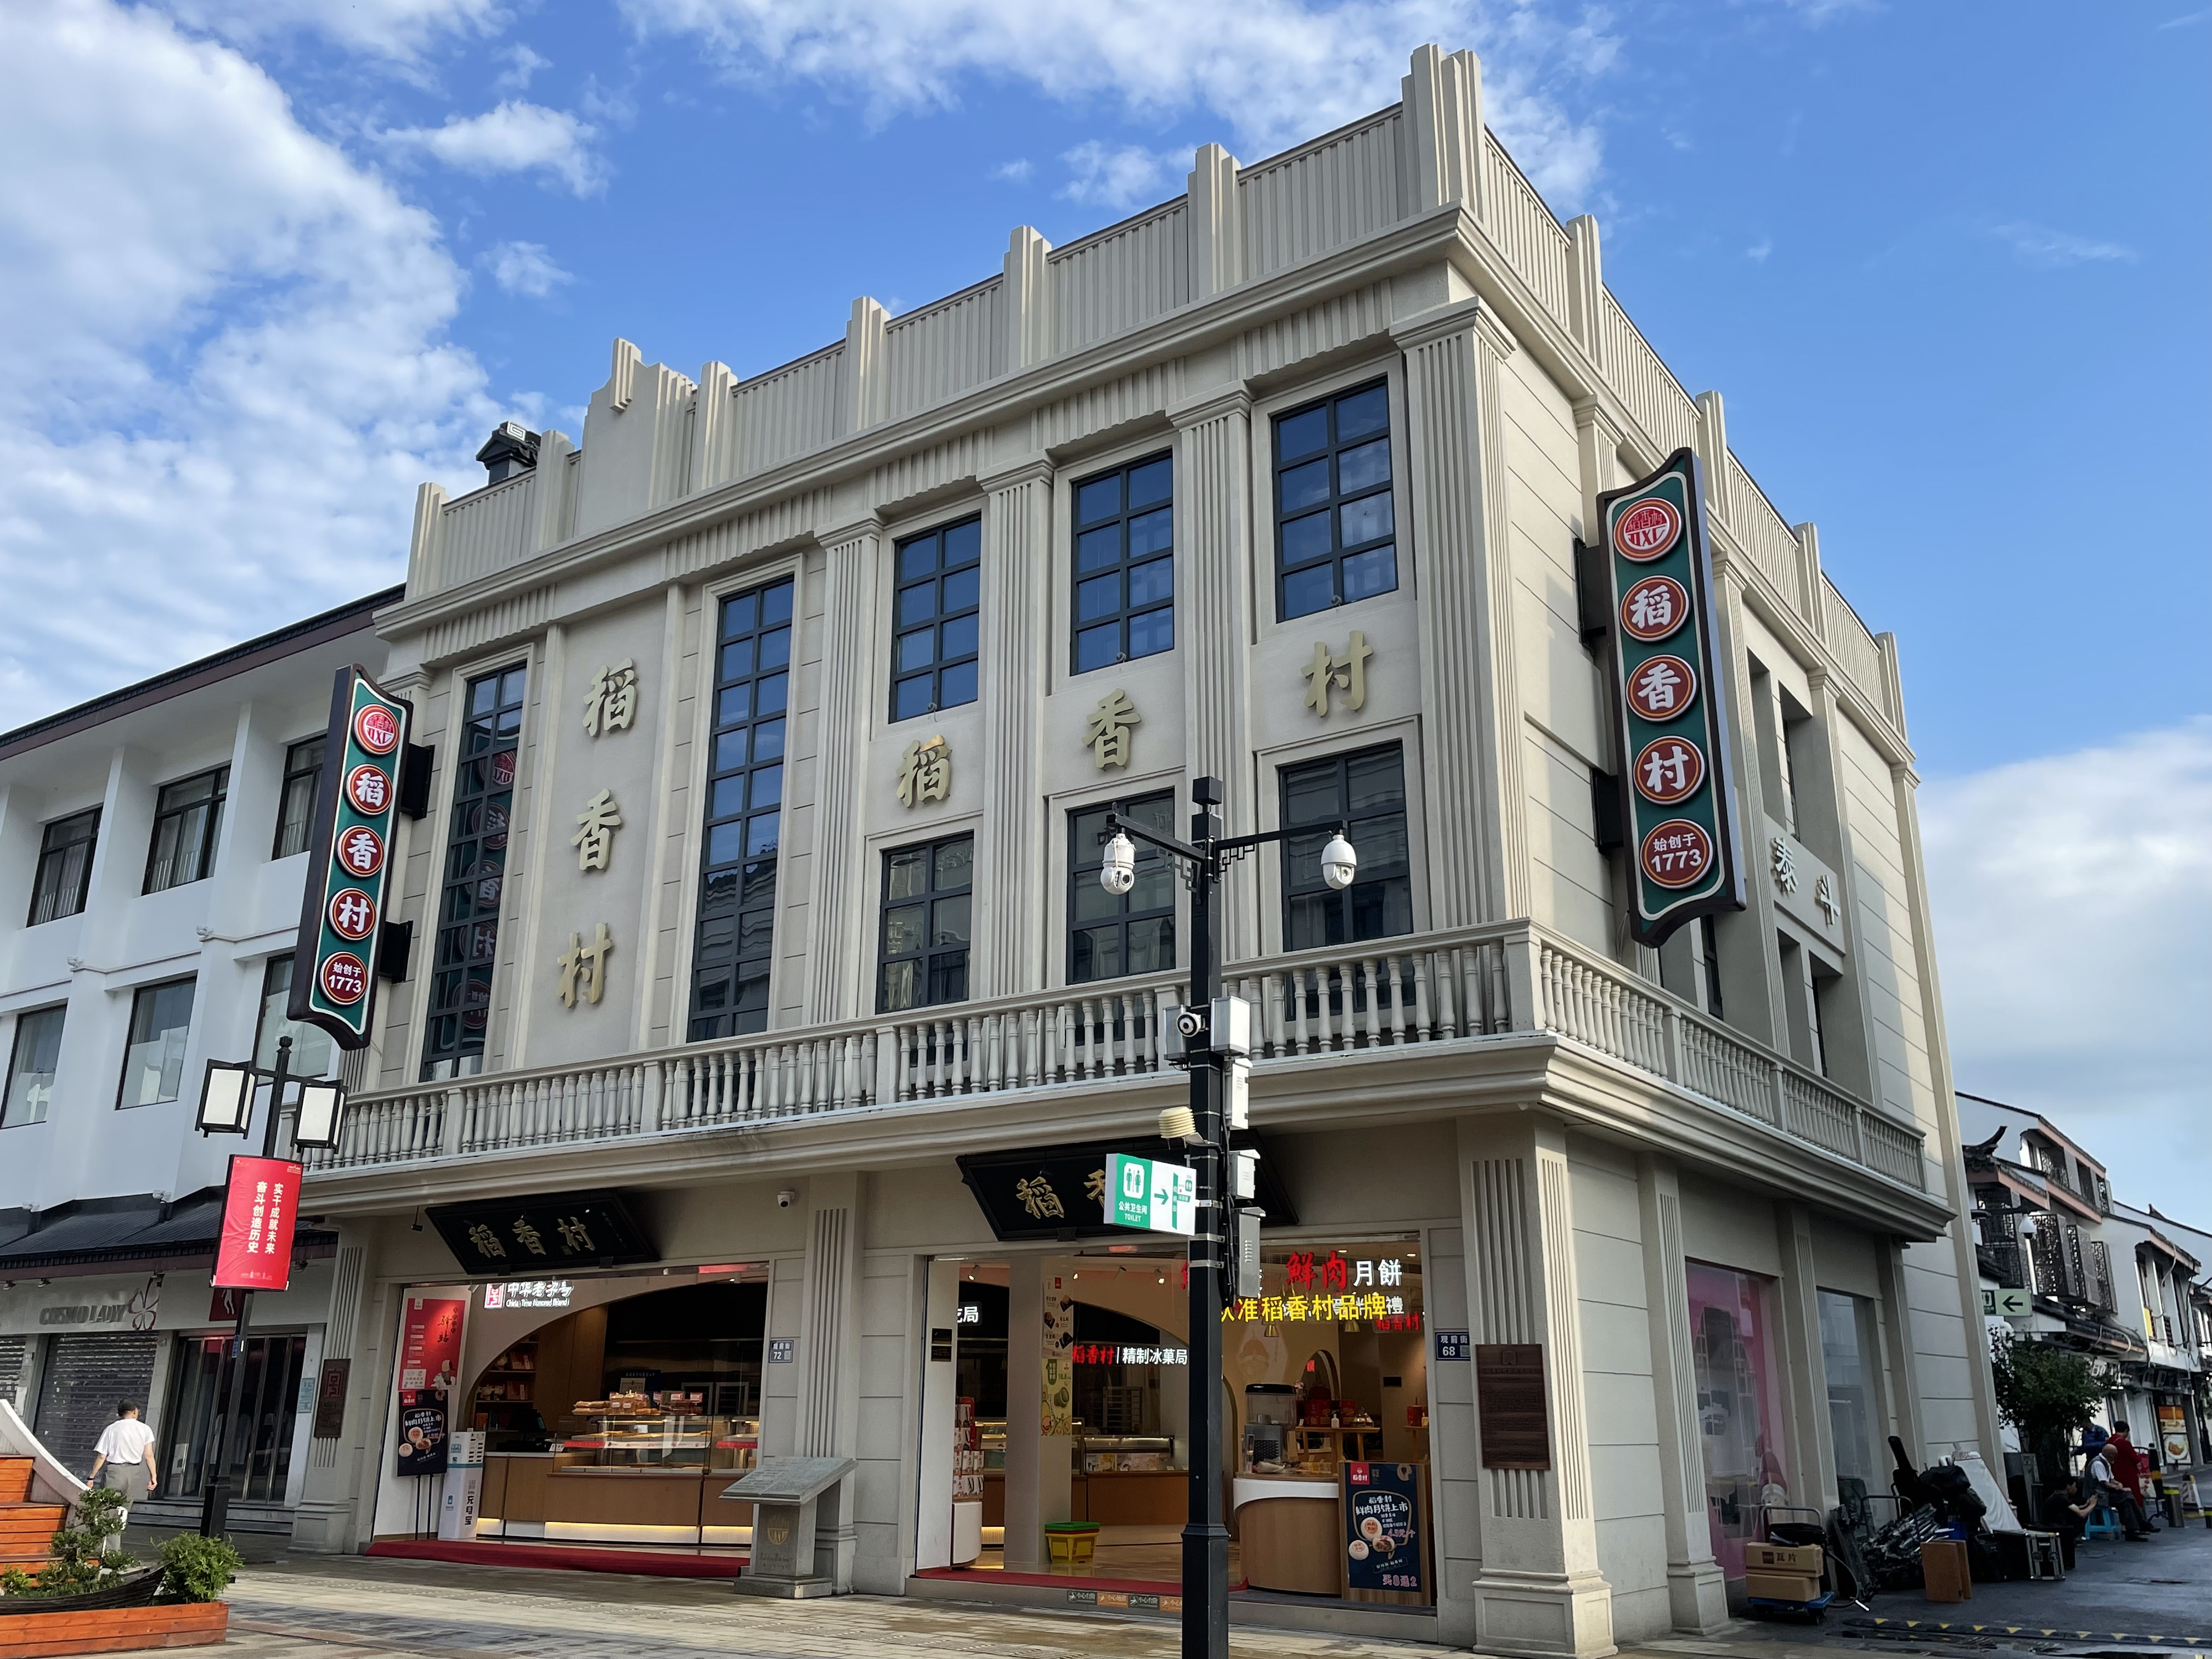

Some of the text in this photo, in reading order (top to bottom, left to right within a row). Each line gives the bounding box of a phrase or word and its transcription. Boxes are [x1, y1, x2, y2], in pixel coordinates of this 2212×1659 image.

[1632, 585, 1688, 793] 稻香村
[557, 658, 636, 1008] 稻香村
[1653, 833, 1696, 853] 始创于
[338, 772, 383, 932] 稻香村
[1651, 849, 1701, 872] 1773
[332, 962, 362, 977] 始创于
[328, 975, 362, 993] 1773
[247, 1181, 268, 1253] 奋斗创造历史
[1118, 1201, 1148, 1215] 公共卫生间
[1125, 1214, 1141, 1222] TOILET
[265, 1183, 284, 1254] 实干成就未来
[469, 1216, 595, 1258] 稻香村
[774, 1351, 782, 1359] 72
[1122, 1347, 1188, 1365] 精制冰菓局
[1442, 1346, 1455, 1356] 68
